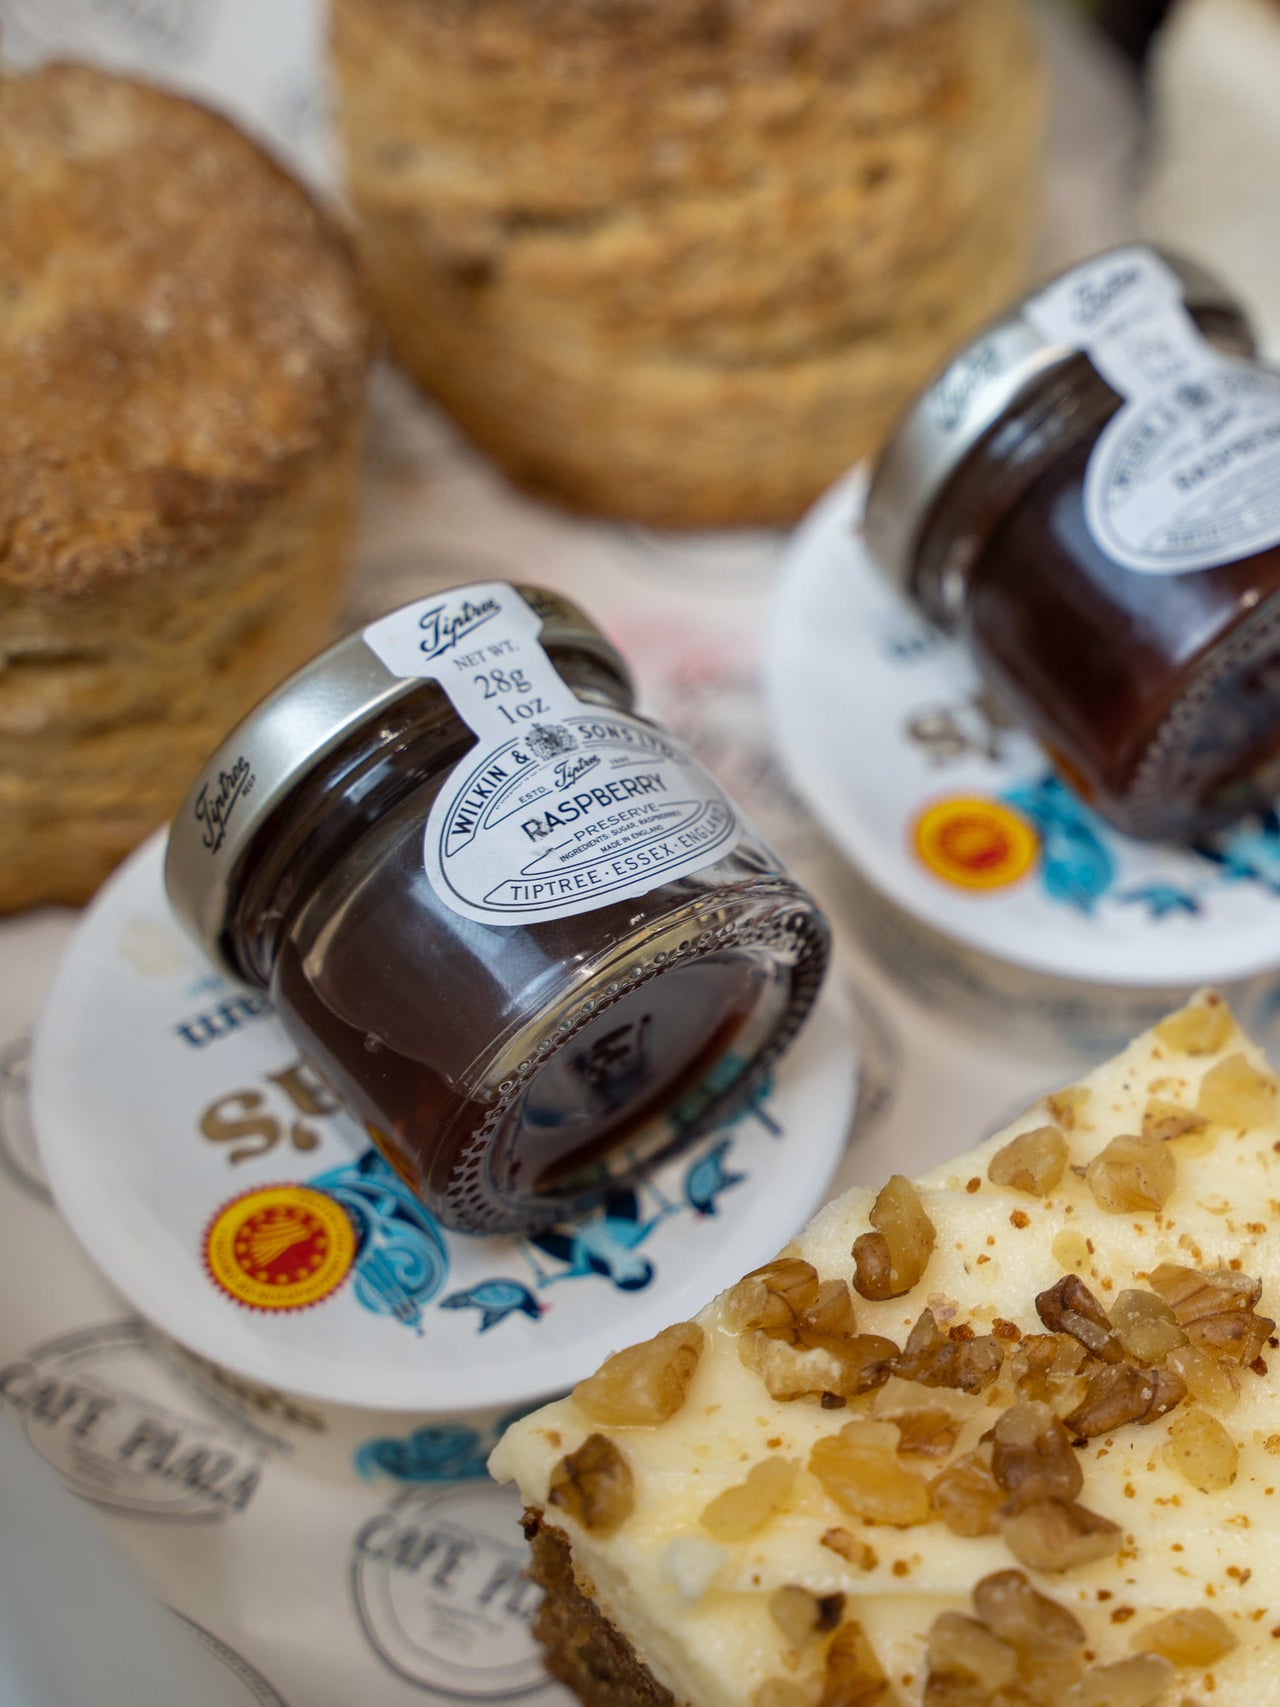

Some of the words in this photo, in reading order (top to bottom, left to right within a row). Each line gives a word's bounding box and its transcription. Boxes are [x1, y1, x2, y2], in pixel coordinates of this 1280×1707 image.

[418, 598, 502, 661] Tiptree
[453, 650, 487, 671] NET
[474, 668, 532, 700] 28g
[497, 698, 550, 725] 1oz
[451, 765, 508, 835] WILKIN
[511, 750, 530, 764] &
[578, 725, 633, 743] SONS
[554, 754, 602, 792] Tiptree
[195, 756, 250, 855] Tiptree
[521, 773, 667, 842] RASPBERRY
[573, 802, 660, 842] PRESERVE
[510, 869, 602, 901] TIPTREE
[612, 843, 675, 876] ESSEX
[679, 805, 725, 848] ENGLAND
[559, 833, 612, 863] INGREDIENTS:
[611, 821, 638, 836] SUGAR,
[600, 841, 621, 854] MADE
[622, 835, 631, 846] IN
[631, 824, 665, 840] ENGLAND
[120, 1413, 263, 1513] PLAZA
